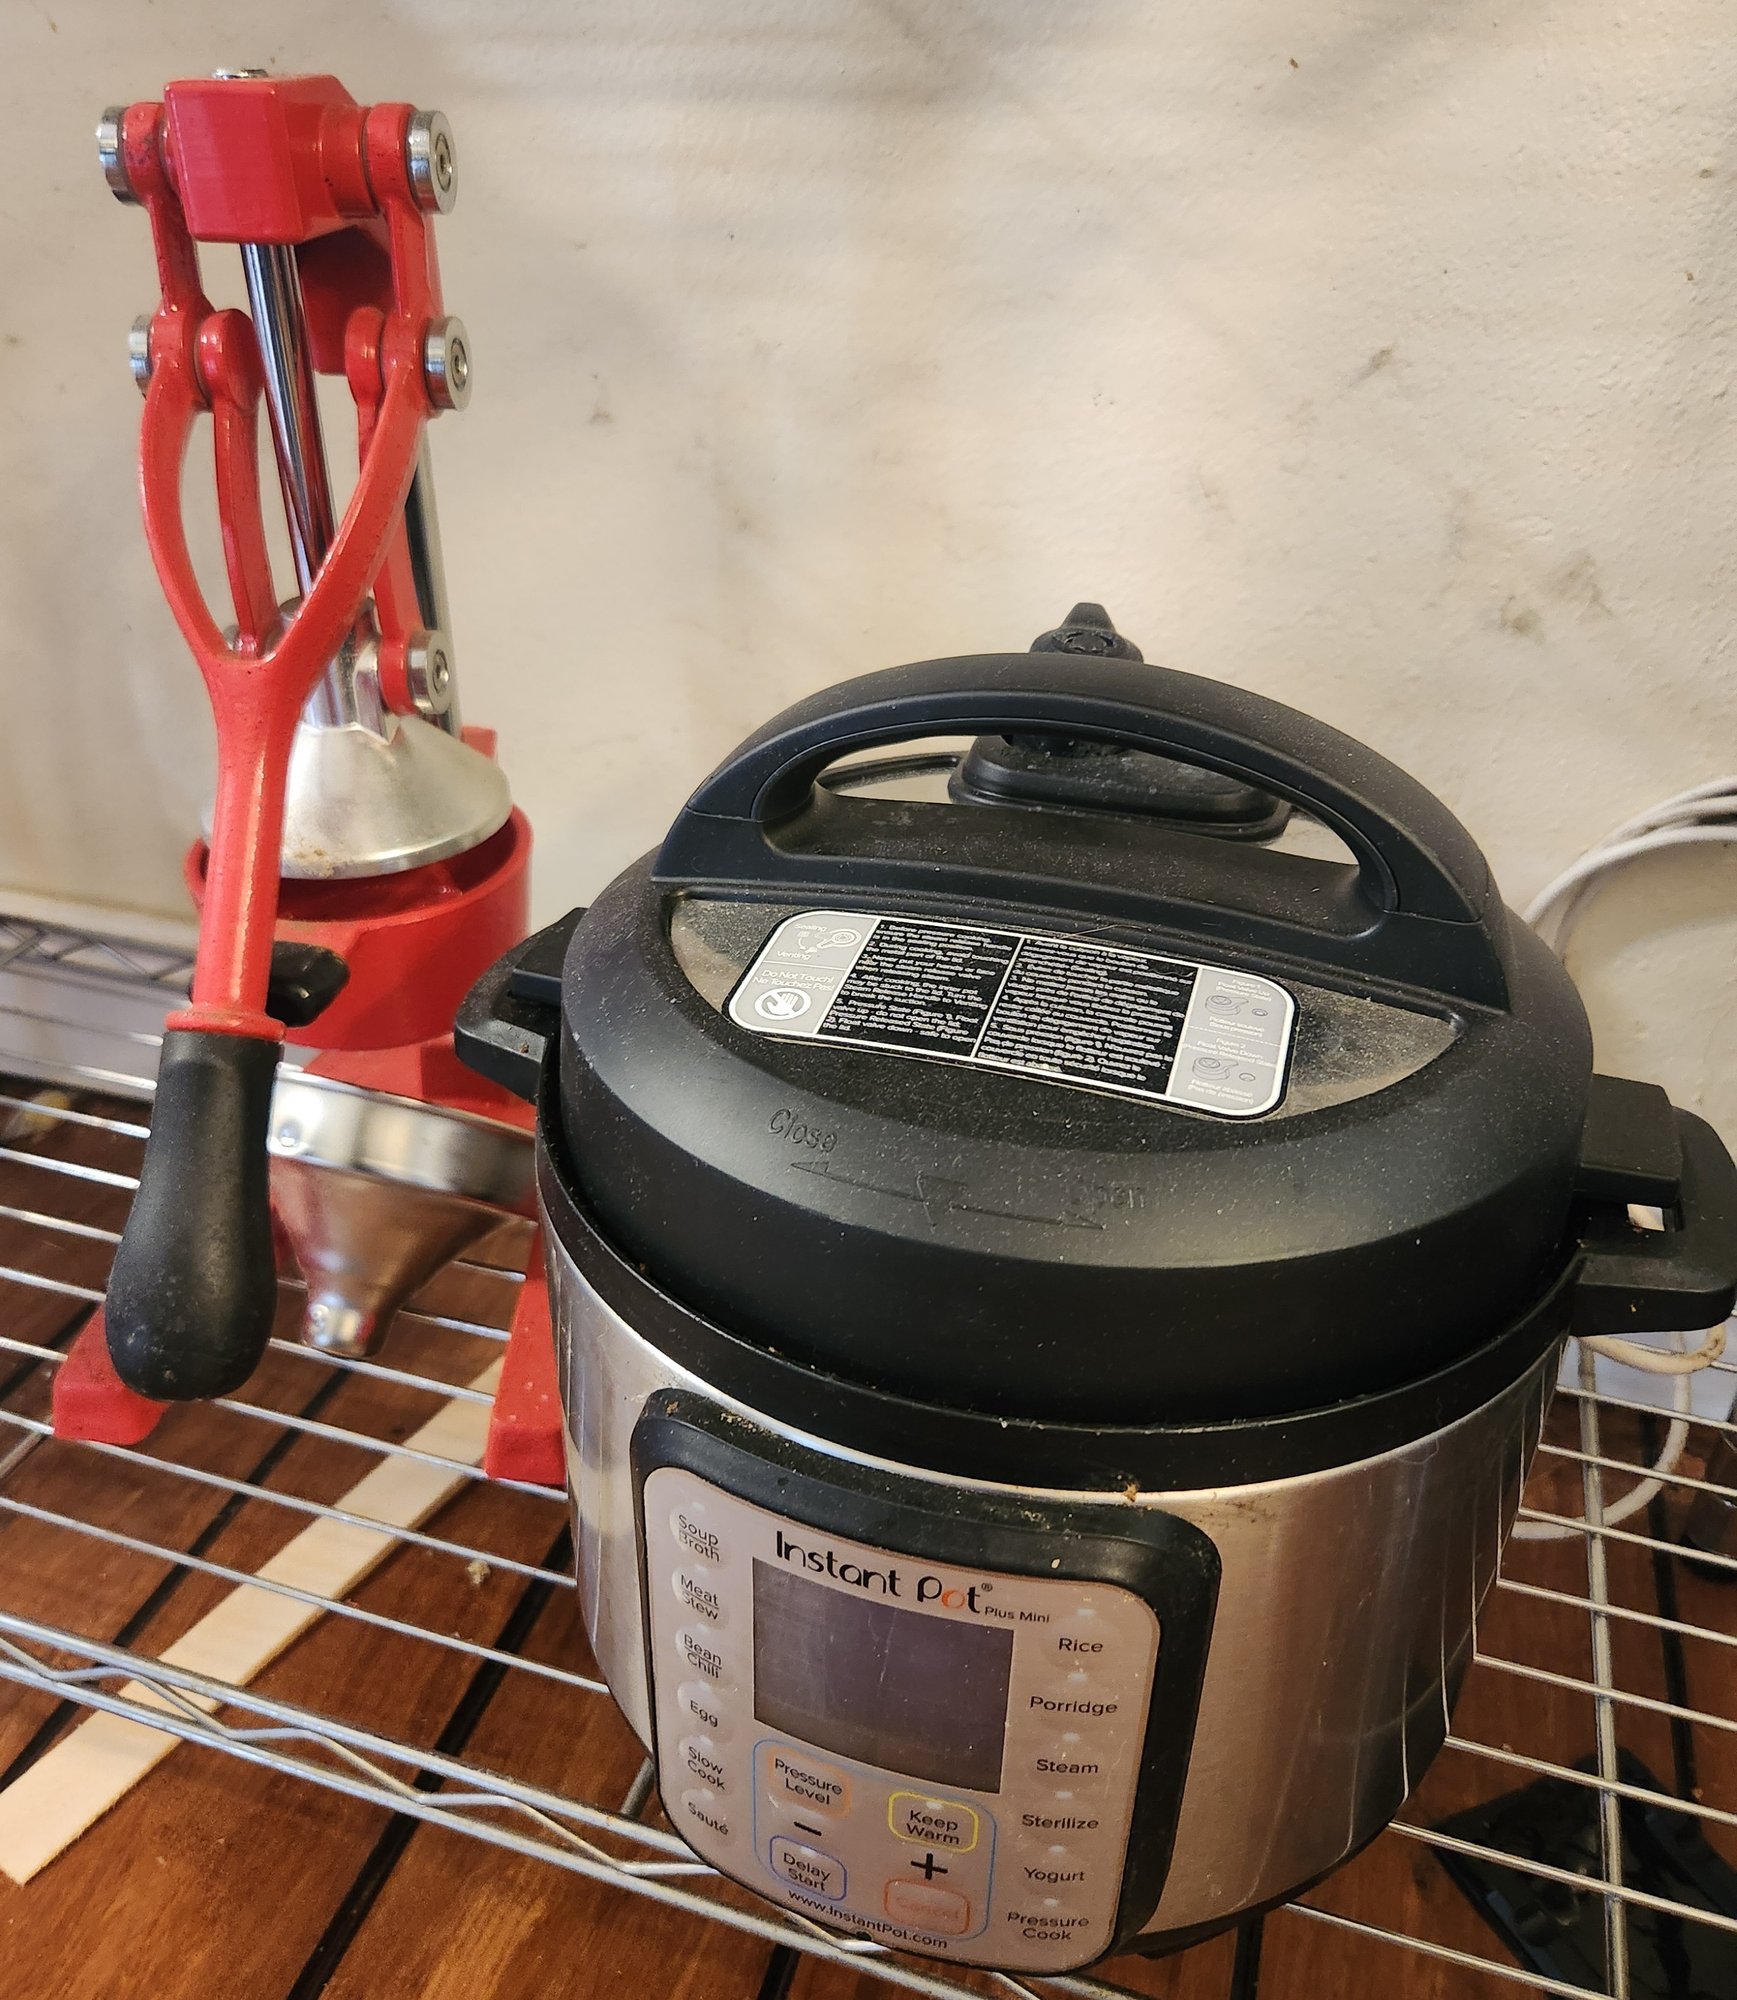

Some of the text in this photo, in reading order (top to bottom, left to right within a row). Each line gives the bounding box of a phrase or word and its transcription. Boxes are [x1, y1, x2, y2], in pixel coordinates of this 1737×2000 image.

[776, 951, 811, 961] Venting
[752, 977, 768, 985] Ne
[771, 977, 812, 989] Touchez
[761, 970, 777, 979] Do
[778, 971, 798, 980] Not
[766, 1107, 839, 1154] Close
[678, 1514, 719, 1547] Soup
[679, 1529, 720, 1562] Broth
[776, 1530, 902, 1597] Instant
[680, 1574, 719, 1606] Meat
[682, 1590, 719, 1620] Stew
[984, 1606, 1050, 1623] Plus Mini
[684, 1634, 722, 1666] Bean
[1058, 1637, 1104, 1653] Rice
[687, 1652, 719, 1678] Chili
[690, 1699, 719, 1728] Egg
[1030, 1695, 1118, 1717] Porridge
[688, 1746, 723, 1775] Slow
[1036, 1758, 1099, 1774] Steam
[687, 1759, 725, 1791] Cook
[775, 1757, 843, 1796] Pressure
[785, 1777, 830, 1805] Level
[687, 1801, 729, 1836] Sauté
[909, 1809, 959, 1832] Keep
[1022, 1814, 1099, 1830] Sterilize
[906, 1823, 960, 1845] Warm
[783, 1852, 831, 1882] Delay
[788, 1867, 826, 1892] Start
[1024, 1866, 1086, 1884] Yogurt
[788, 1889, 948, 1949] www.InstantPot.com
[1007, 1911, 1090, 1928] Pressure
[1022, 1927, 1072, 1941] Cook
